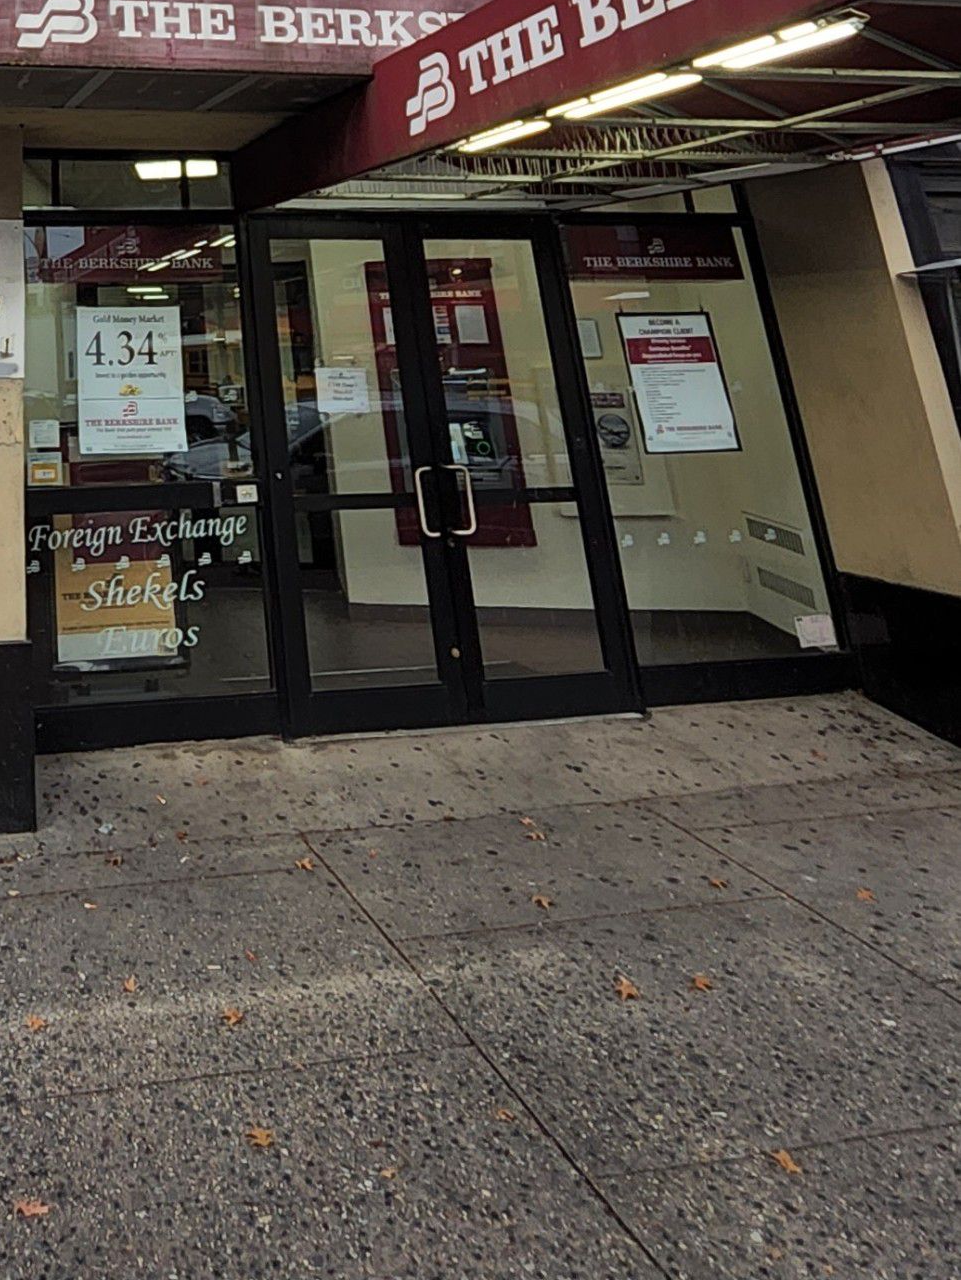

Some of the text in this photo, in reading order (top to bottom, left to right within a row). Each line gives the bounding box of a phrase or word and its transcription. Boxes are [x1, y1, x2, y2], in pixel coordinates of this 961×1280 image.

[110, 0, 235, 41] THE
[459, 5, 565, 95] THE
[171, 257, 214, 269] BANK
[583, 256, 735, 268] THE BERKSHIRE BANK
[84, 330, 158, 366] 4.34
[28, 511, 248, 556] Foreign Exchange
[80, 570, 206, 611] Shekels
[96, 624, 200, 655] Euros
